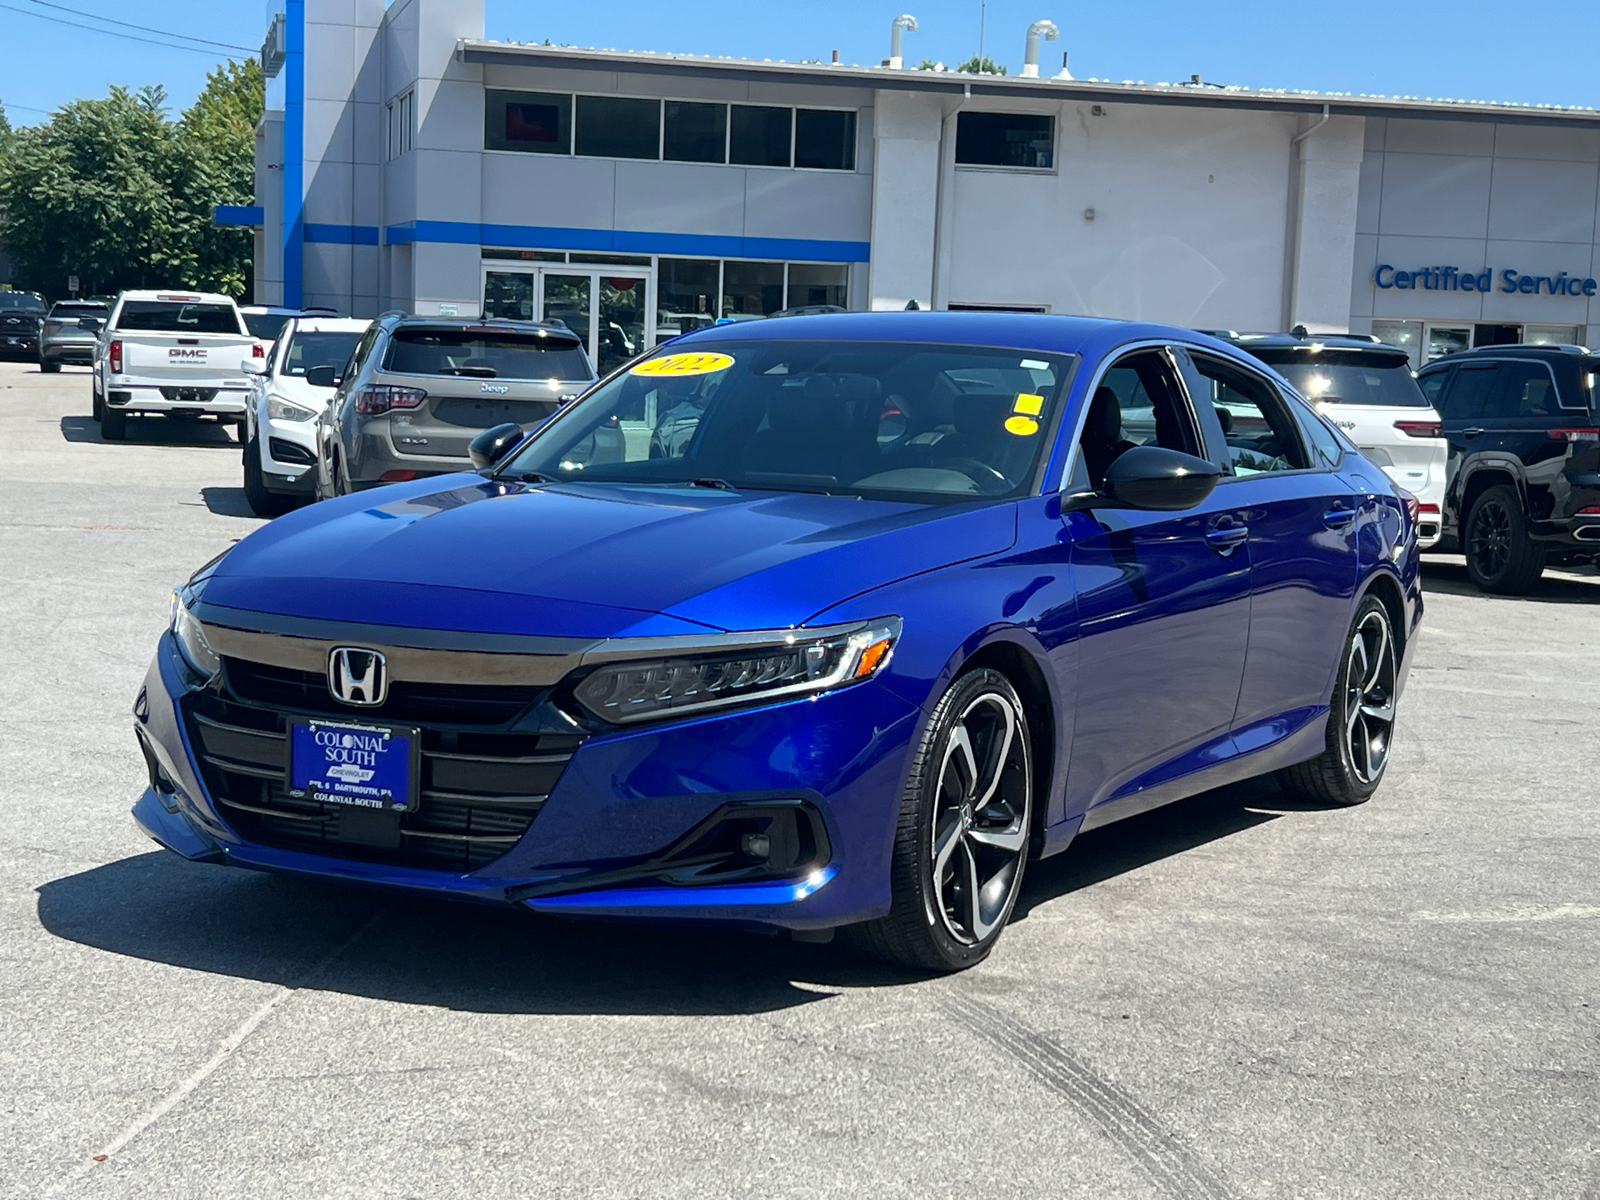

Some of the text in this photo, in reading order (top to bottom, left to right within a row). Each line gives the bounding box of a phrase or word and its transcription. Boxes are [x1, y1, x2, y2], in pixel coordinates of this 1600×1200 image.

[1375, 264, 1598, 297] Certified Service
[169, 349, 208, 358] GMC
[480, 382, 508, 394] Jeep
[402, 437, 428, 445] 4x4
[315, 731, 389, 753] COLONIAL
[325, 747, 376, 766] SOUTH
[331, 767, 371, 779] CHEVROLET
[334, 783, 380, 797] DARTMOUTH,
[313, 792, 384, 809] COLONIAL SOUTH
